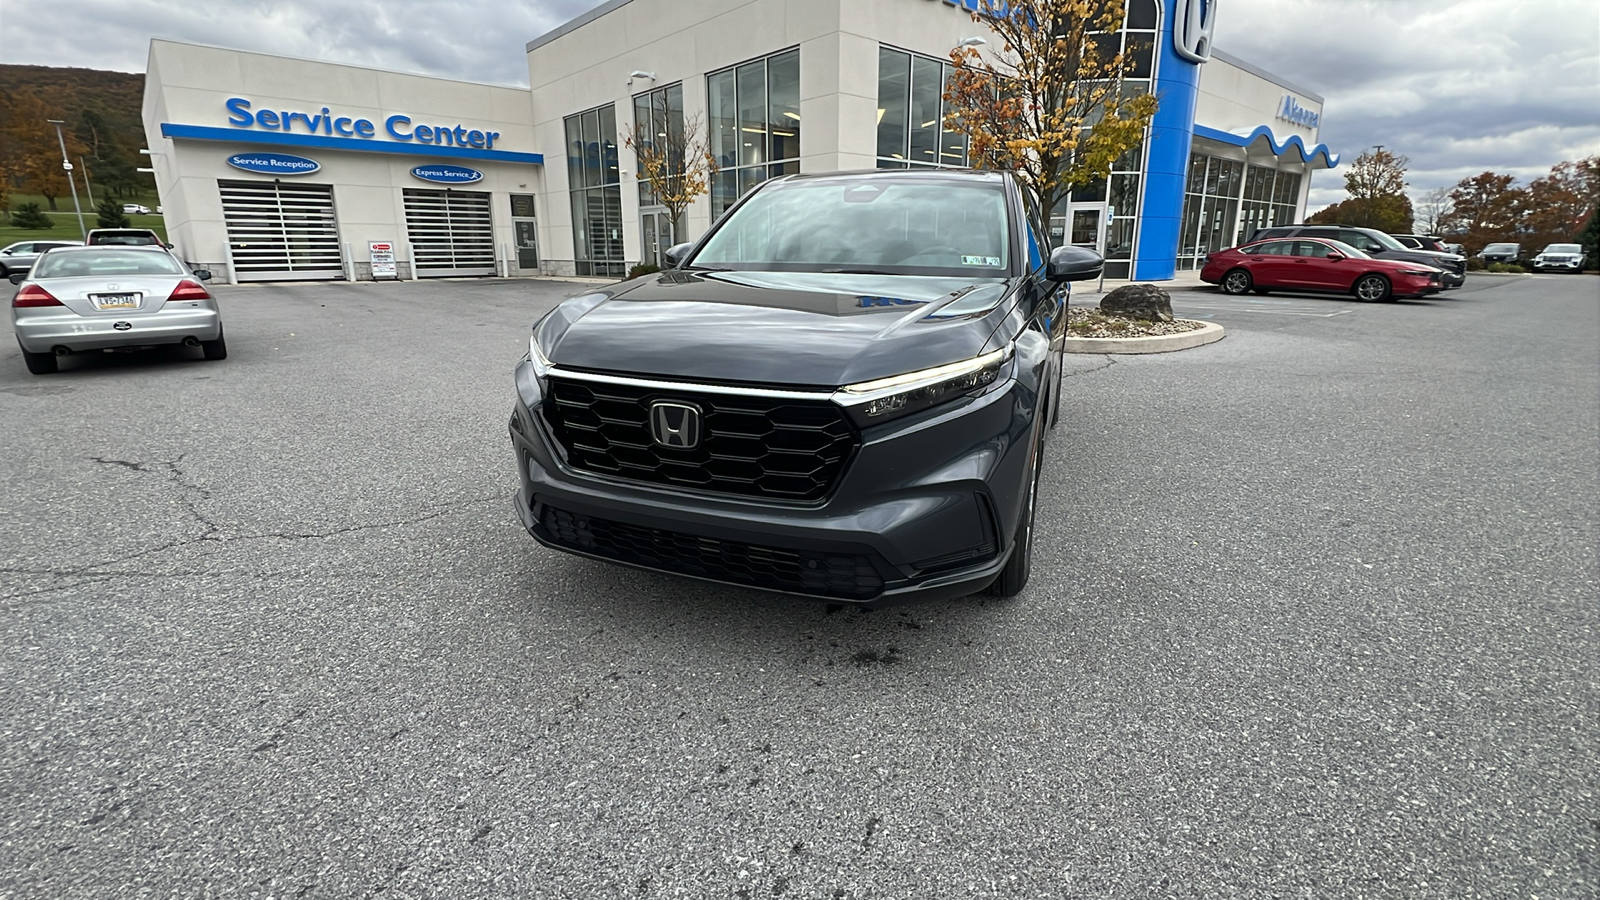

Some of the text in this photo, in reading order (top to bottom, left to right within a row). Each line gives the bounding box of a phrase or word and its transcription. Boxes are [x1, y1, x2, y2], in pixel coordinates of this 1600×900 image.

[226, 97, 500, 149] Service Center
[233, 156, 315, 169] Service Reception
[415, 168, 470, 179] Express Service
